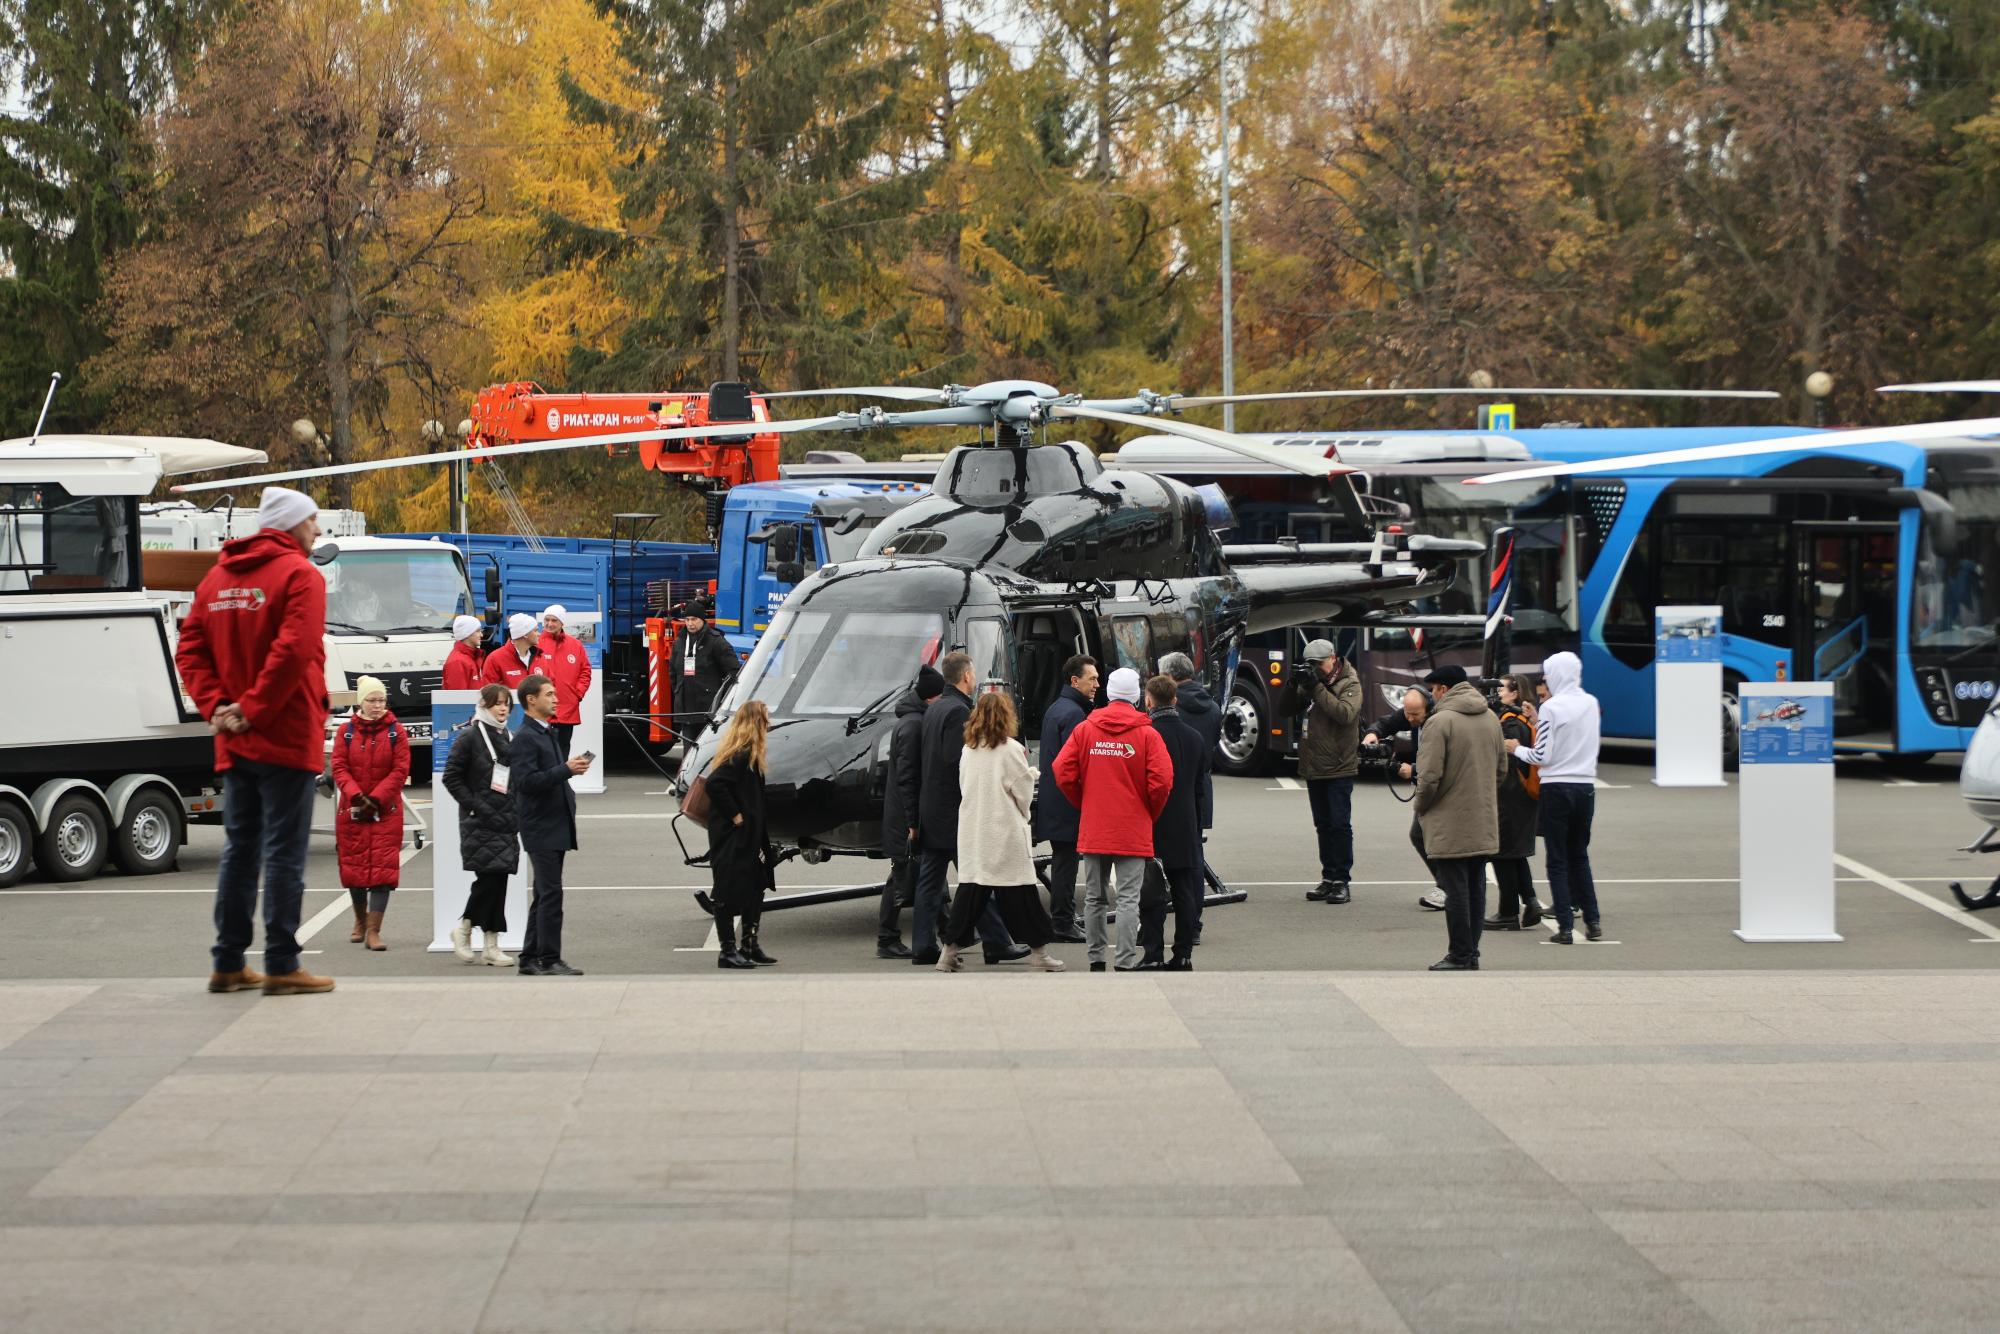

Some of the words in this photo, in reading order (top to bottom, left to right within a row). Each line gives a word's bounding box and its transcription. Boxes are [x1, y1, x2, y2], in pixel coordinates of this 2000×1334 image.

[563, 413, 619, 426] РИАТ-КРАН
[1095, 741, 1115, 749] MADE
[1089, 748, 1124, 757] ATARSTAN
